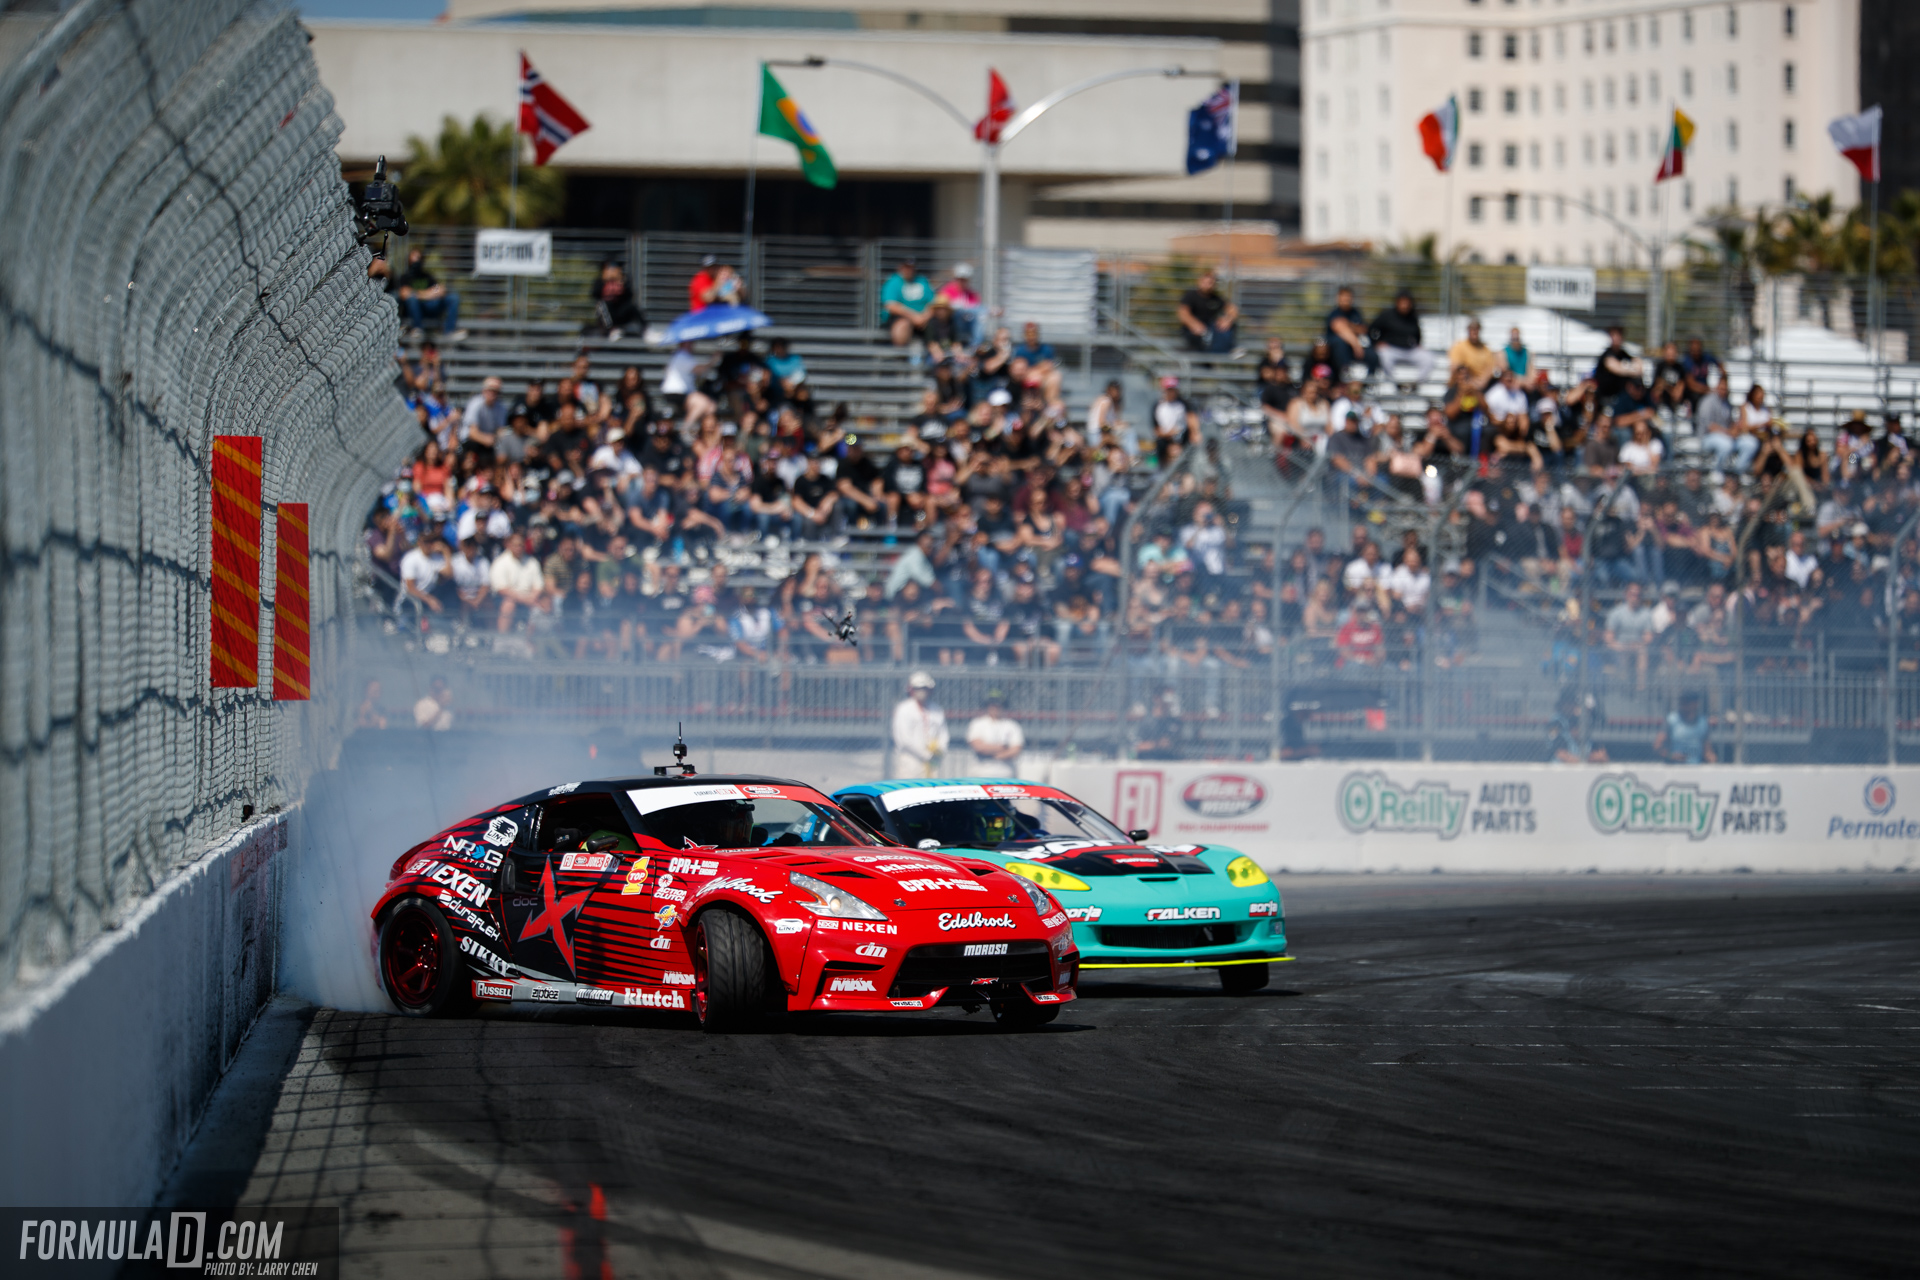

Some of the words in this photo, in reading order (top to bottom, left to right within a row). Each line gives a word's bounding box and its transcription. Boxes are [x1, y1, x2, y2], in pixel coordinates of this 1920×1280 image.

[1341, 775, 1464, 834] O'Reilly
[1480, 782, 1531, 805] AUTO
[1729, 783, 1781, 806] AUTO
[1590, 776, 1715, 835] O'Reilly
[1472, 810, 1537, 834] PARTS
[1722, 810, 1788, 834] PARTS
[420, 861, 492, 908] NEXEN
[629, 872, 646, 881] TOP
[938, 911, 1017, 931] Edelbrock
[1145, 907, 1221, 921] FALKEN
[842, 921, 898, 935] NEXEN
[460, 936, 512, 977] SIKKY
[477, 983, 513, 998] RUSSELL
[830, 979, 877, 991] MAX
[624, 987, 685, 1009] klutch
